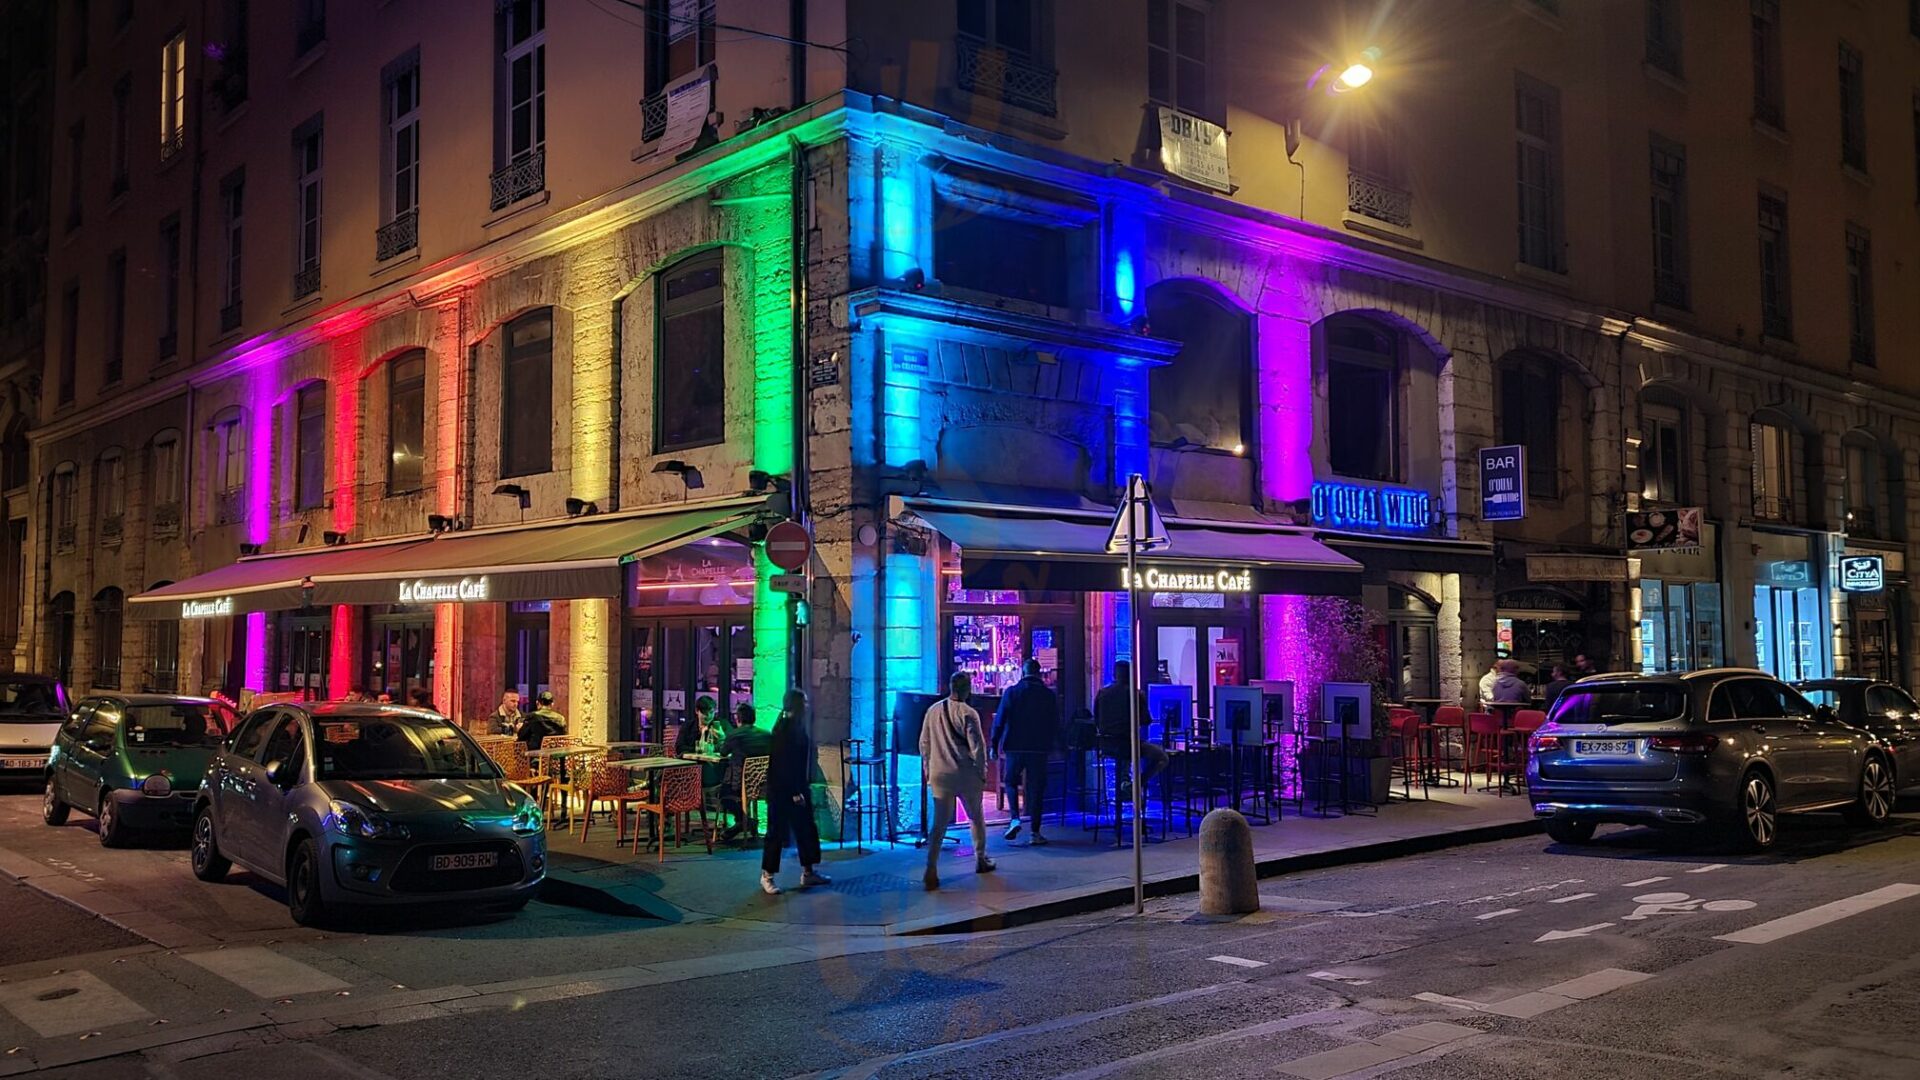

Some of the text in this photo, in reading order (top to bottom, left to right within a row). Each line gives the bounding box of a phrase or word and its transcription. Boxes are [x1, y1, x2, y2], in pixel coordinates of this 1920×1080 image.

[1486, 456, 1515, 470] BAR
[1145, 568, 1215, 590] CHAPELLE
[1581, 740, 1628, 752] EX-739-SZ
[436, 853, 492, 869] BD-909-RW
